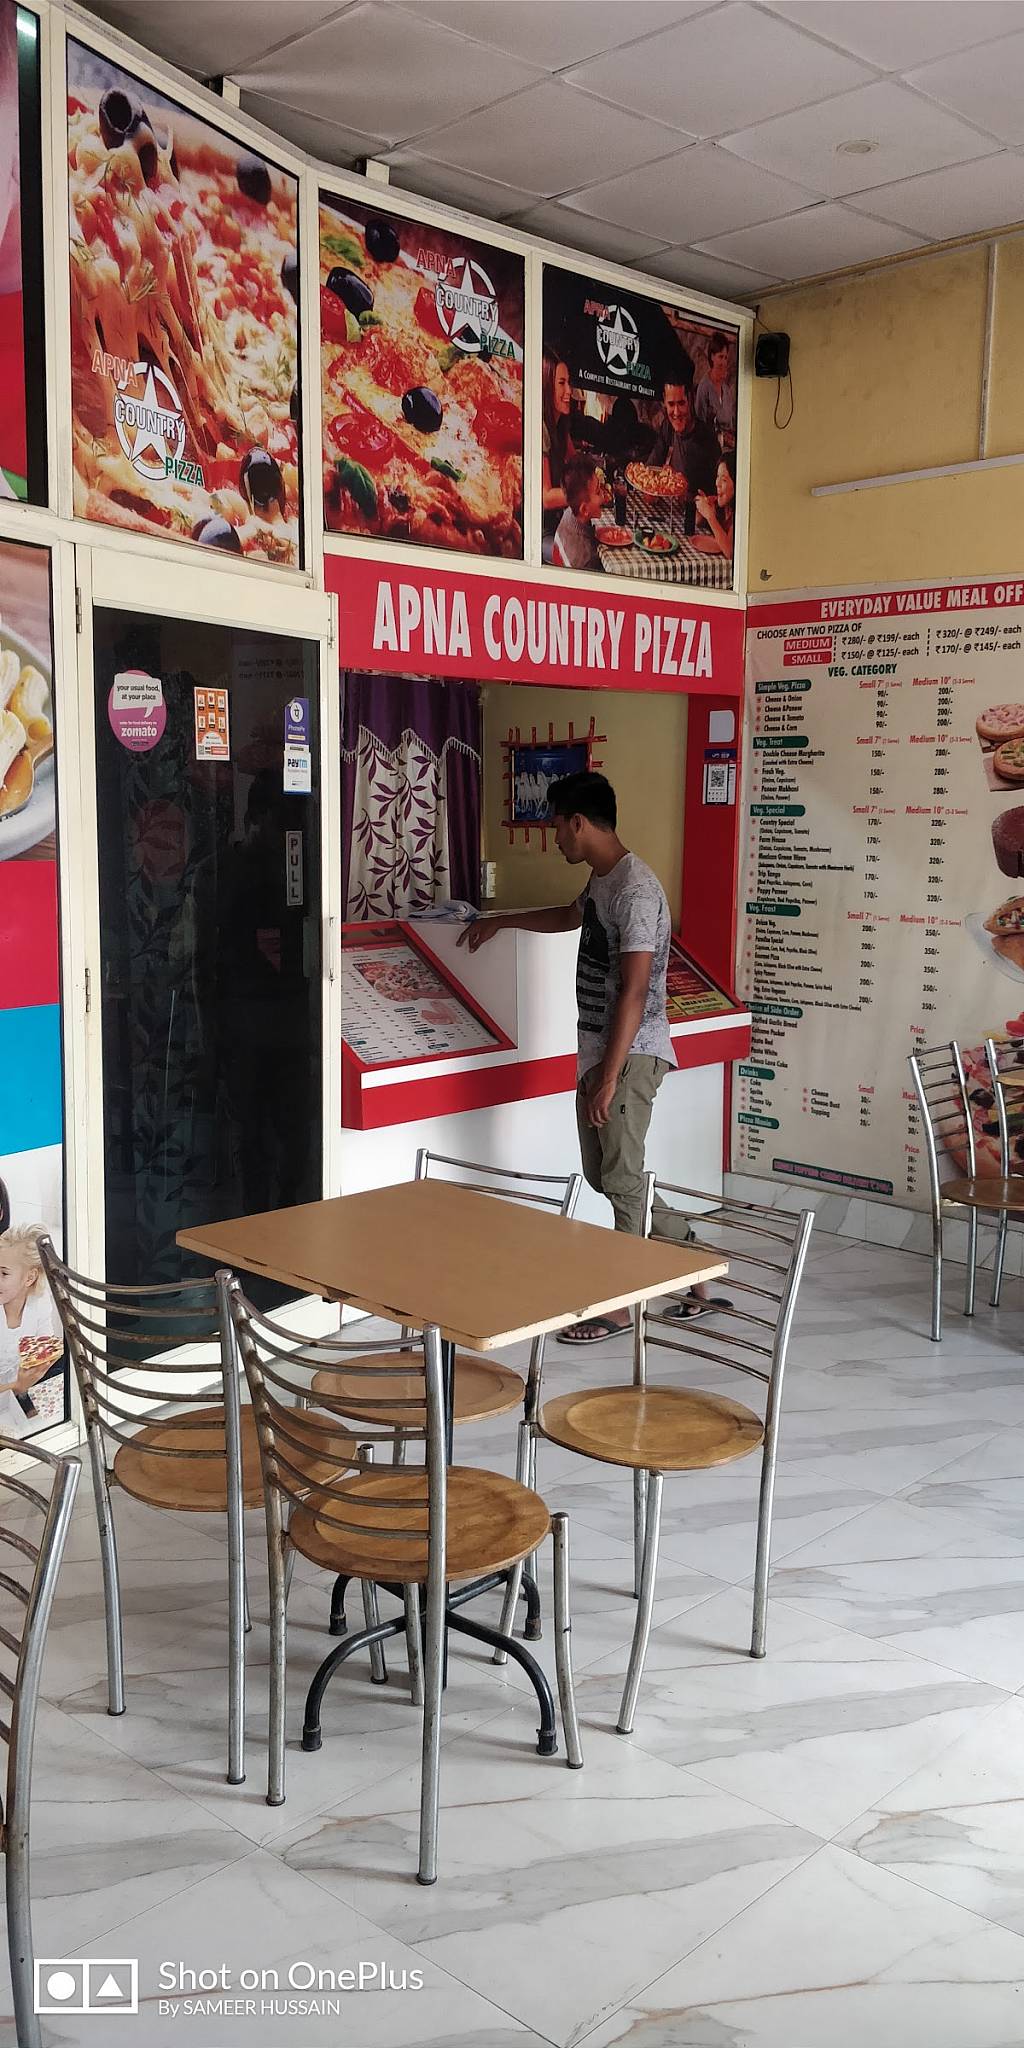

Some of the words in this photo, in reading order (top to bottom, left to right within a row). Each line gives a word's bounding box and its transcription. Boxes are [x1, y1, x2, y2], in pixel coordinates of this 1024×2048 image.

[416, 248, 456, 277] APNA
[436, 288, 498, 322] COUNTRY
[584, 300, 610, 320] APNA
[597, 328, 639, 352] COUNTRY
[480, 334, 515, 360] PIZZA
[92, 350, 138, 387] APNA
[579, 369, 582, 378] A
[627, 361, 651, 380] PIZZA
[114, 399, 184, 442] COUNTRY
[165, 456, 203, 486] PIZZA
[821, 596, 891, 618] EVERYDAY
[896, 592, 942, 612] VALUE
[947, 587, 988, 607] MEAL
[373, 581, 472, 657] APNA
[484, 595, 625, 669] COUNTRY
[634, 613, 713, 677] PIZZA
[757, 629, 787, 639] CHOOSE
[789, 628, 805, 636] ANY
[807, 626, 825, 635] TWO
[828, 624, 849, 633] PIZZA
[852, 623, 862, 632] OF
[964, 628, 972, 638] @
[1003, 625, 1021, 634] each
[786, 638, 830, 650] MEDIUM
[868, 635, 875, 644] @
[903, 632, 919, 641] each
[867, 650, 874, 659] @
[903, 647, 919, 655] each
[964, 644, 971, 653] @
[1003, 641, 1020, 649] each
[792, 655, 822, 664] SMALL
[828, 667, 848, 677] VEG.
[851, 664, 897, 676] CATEGORY
[912, 678, 938, 686] Medium
[121, 726, 157, 737] zomato
[910, 735, 935, 743] Medium
[766, 806, 785, 814] Special
[906, 806, 931, 814] Medium
[900, 914, 925, 923] Medium
[911, 1025, 925, 1034] Price
[741, 1067, 758, 1076] Drinks
[811, 1089, 828, 1097] Cheese
